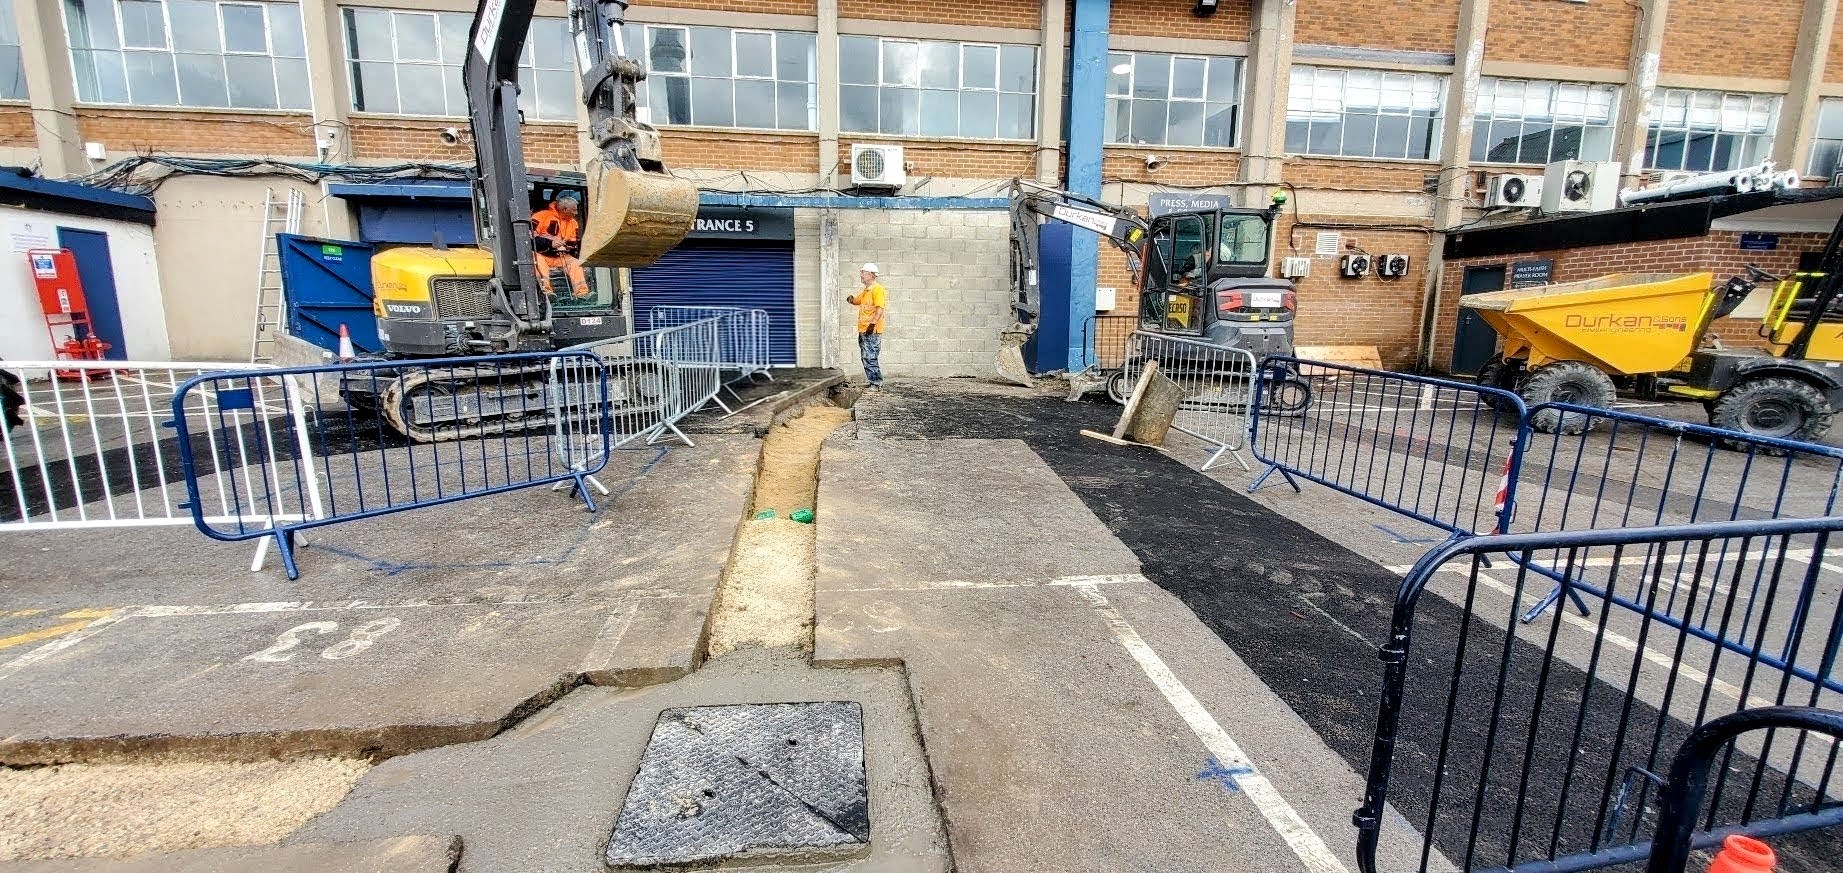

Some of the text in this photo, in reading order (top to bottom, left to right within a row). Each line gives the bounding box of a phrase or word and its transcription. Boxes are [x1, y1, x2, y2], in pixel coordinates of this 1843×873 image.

[1160, 199, 1219, 209] PRESS, MEDIA
[690, 218, 754, 232] TRANCE 5
[387, 304, 421, 313] VOLVO
[1565, 314, 1652, 328] Durkan
